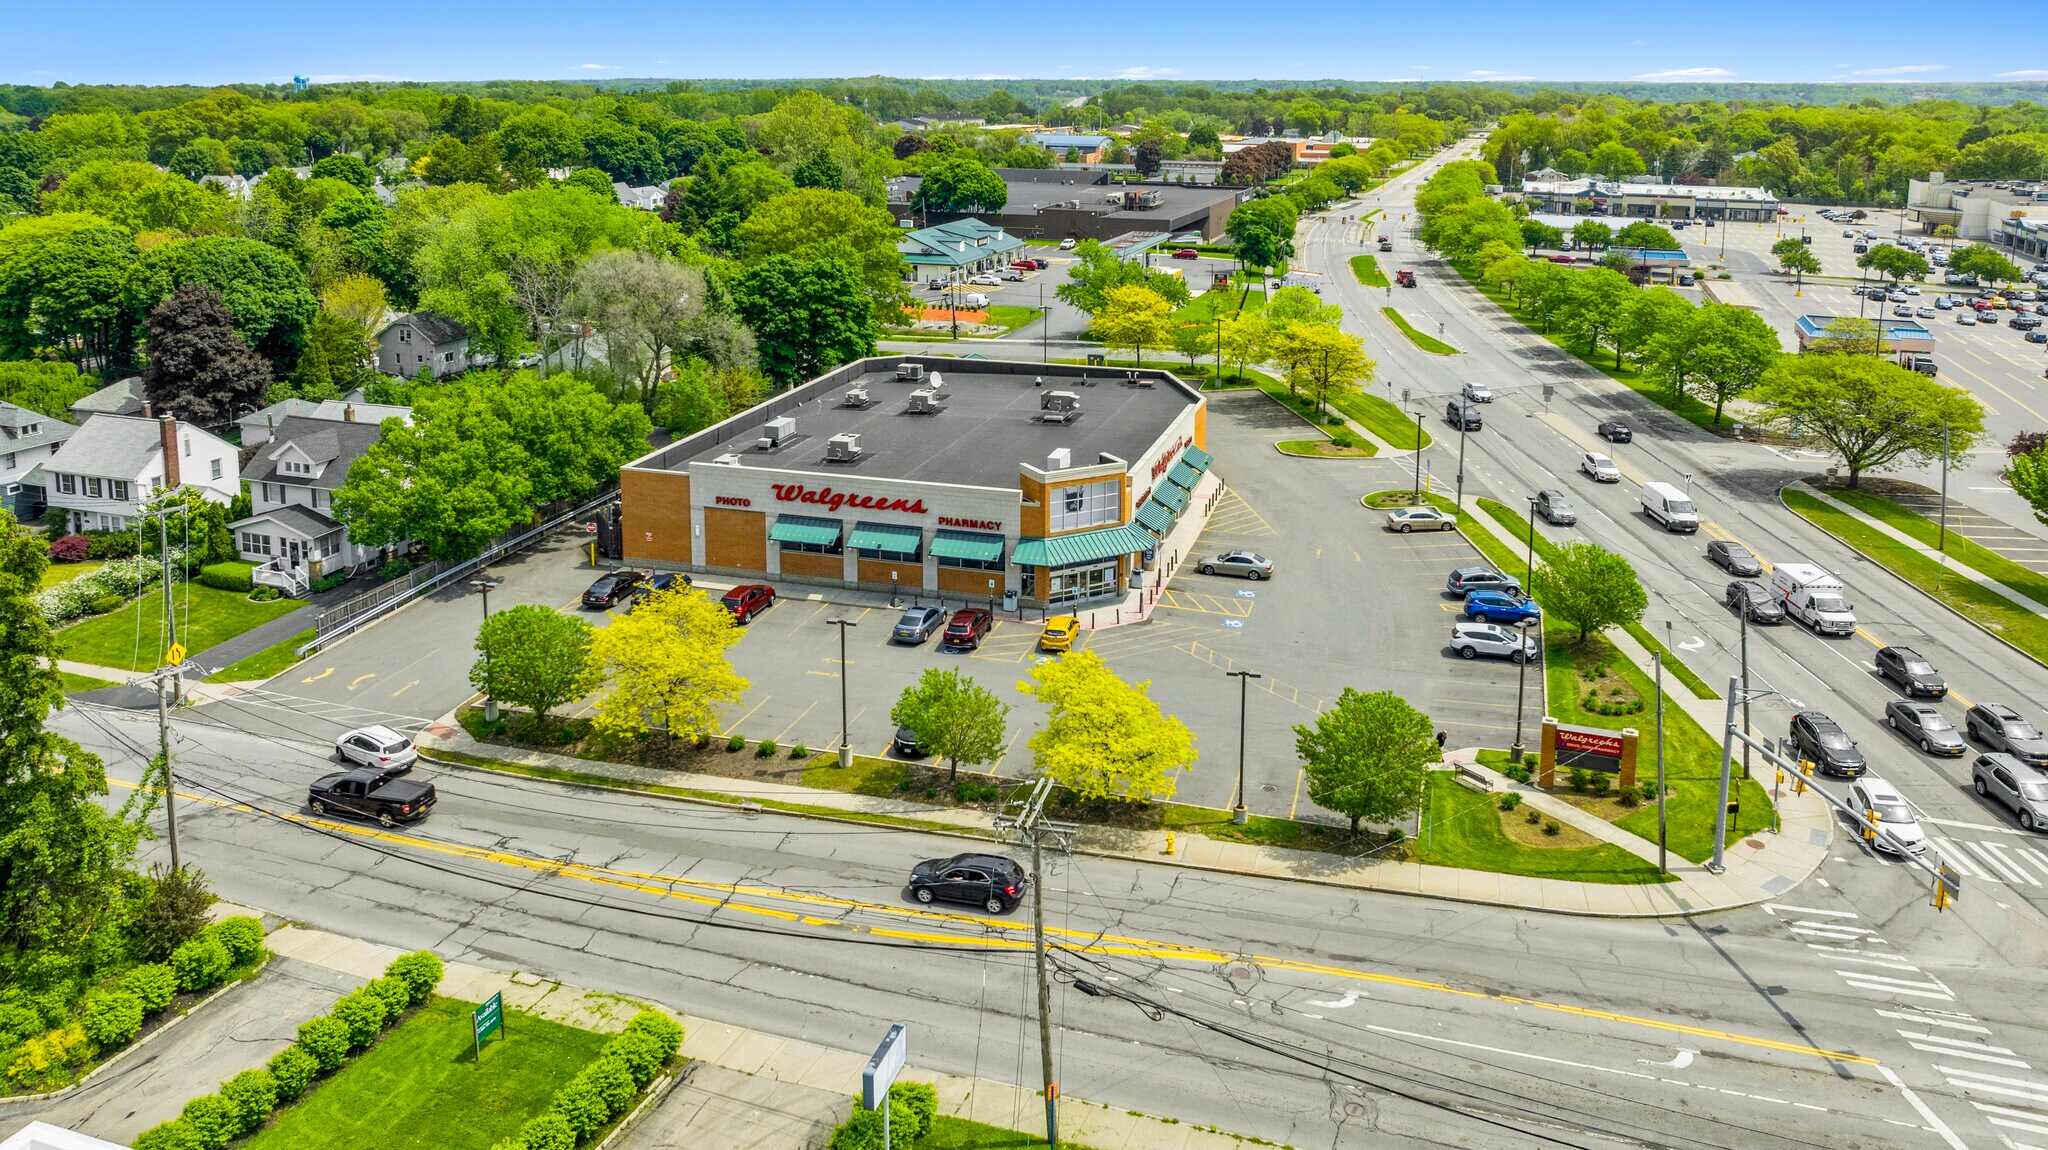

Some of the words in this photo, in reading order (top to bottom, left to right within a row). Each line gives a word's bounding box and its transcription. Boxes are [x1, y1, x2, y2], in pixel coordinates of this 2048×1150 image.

[715, 496, 751, 507] PHOTO
[771, 484, 928, 514] Walgreens
[938, 516, 1002, 531] PHARMACY
[1559, 732, 1620, 748] Walgreens
